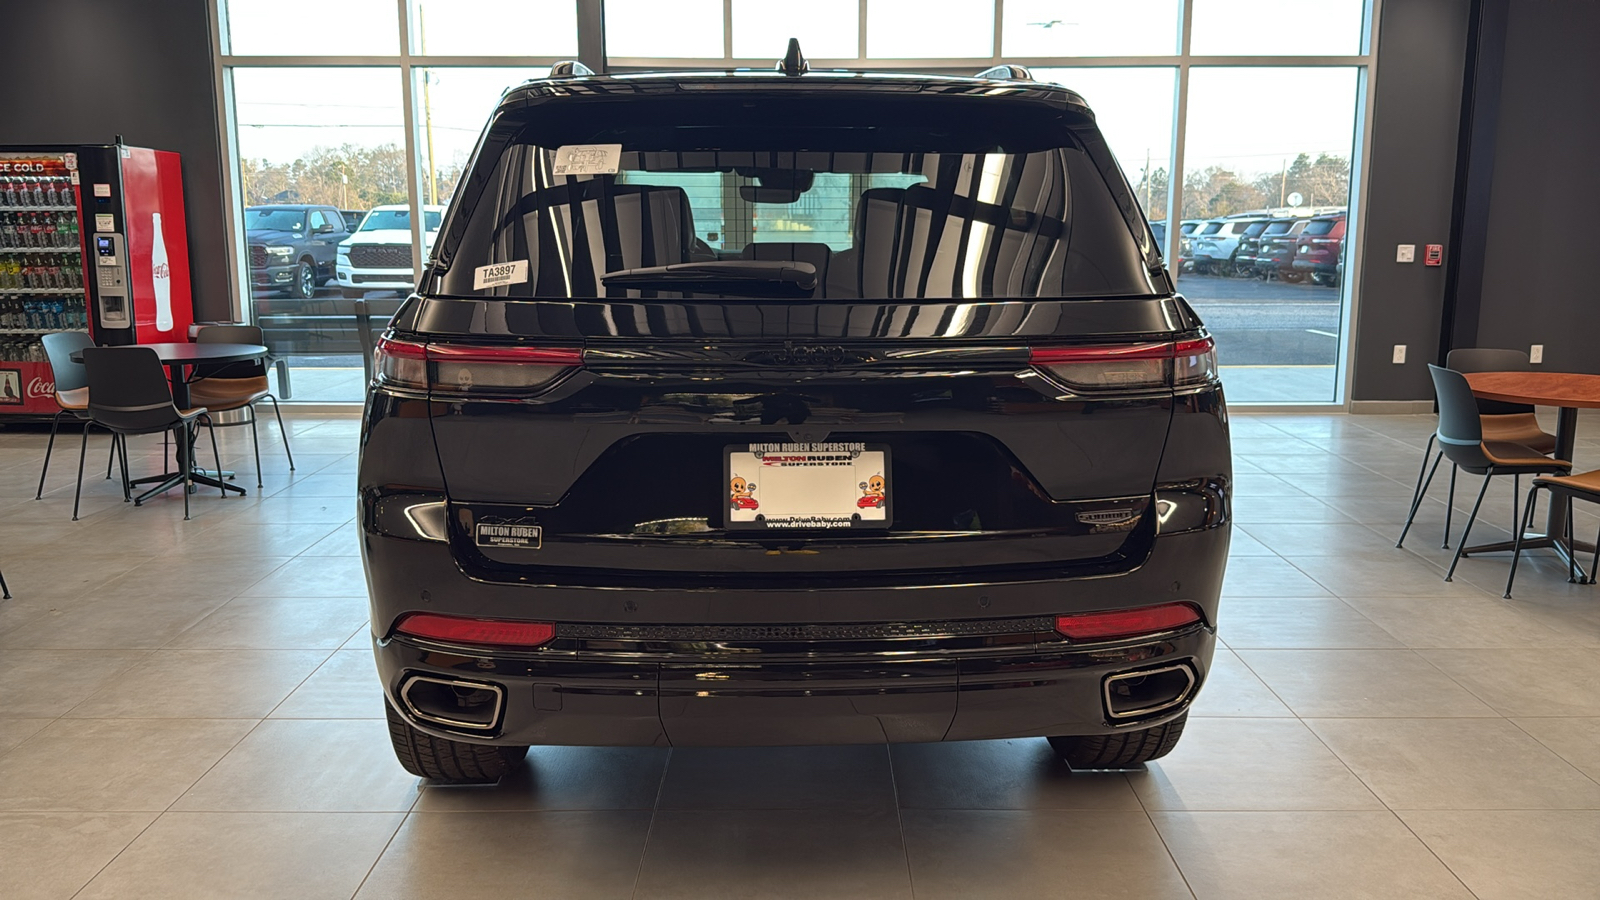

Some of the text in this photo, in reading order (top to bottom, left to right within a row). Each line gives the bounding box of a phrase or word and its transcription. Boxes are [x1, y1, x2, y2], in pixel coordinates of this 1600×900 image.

[13, 163, 44, 172] COLD
[482, 264, 516, 278] TA3897
[749, 442, 866, 452] MILTON RUBEN SUPERSTORE
[766, 521, 851, 529] www.drivebaby.com
[480, 525, 539, 538] MILTON RUBEN
[490, 536, 529, 544] SUPERSTORE
